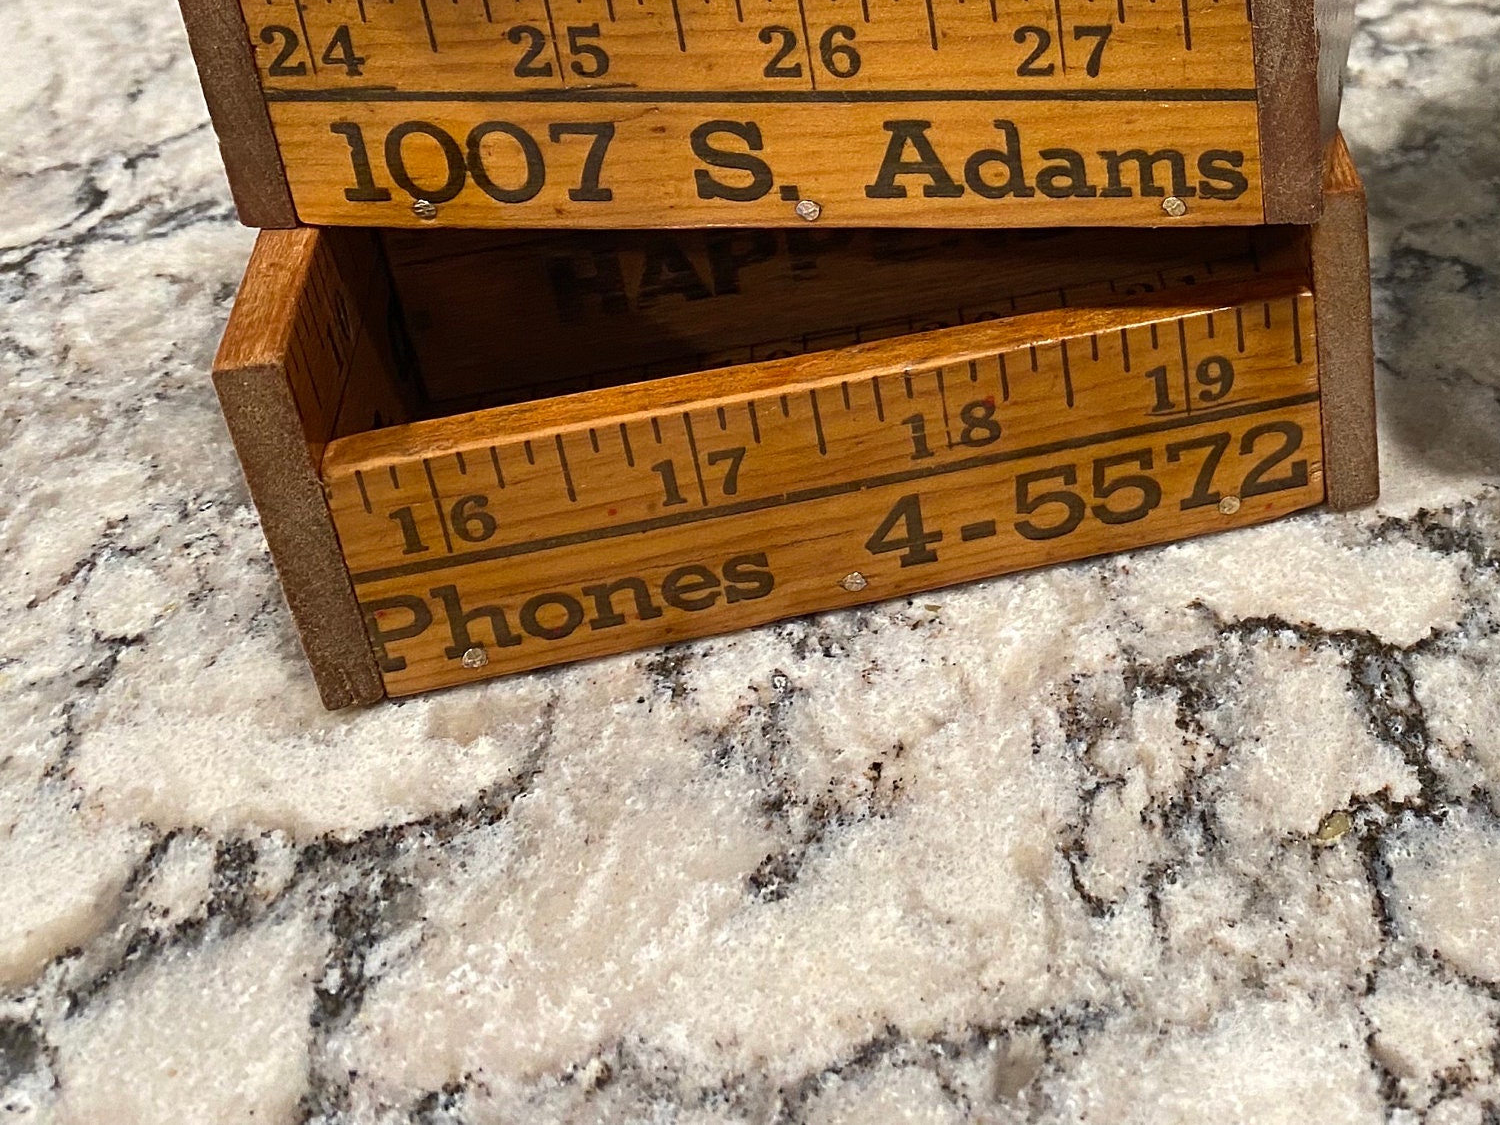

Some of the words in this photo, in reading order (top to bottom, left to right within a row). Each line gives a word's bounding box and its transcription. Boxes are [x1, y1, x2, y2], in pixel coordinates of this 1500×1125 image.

[260, 25, 366, 77] 24
[507, 23, 610, 78] 25
[758, 25, 861, 78] 26
[1013, 24, 1112, 78] 27
[330, 121, 615, 203] 1007
[690, 120, 797, 202] S.
[865, 120, 1249, 201] Adams
[389, 494, 498, 556] 16
[651, 446, 747, 508] 17
[902, 400, 1002, 460] 18
[1144, 355, 1236, 414] 19
[361, 552, 775, 674] Phones
[864, 420, 1308, 569] 4-5572
